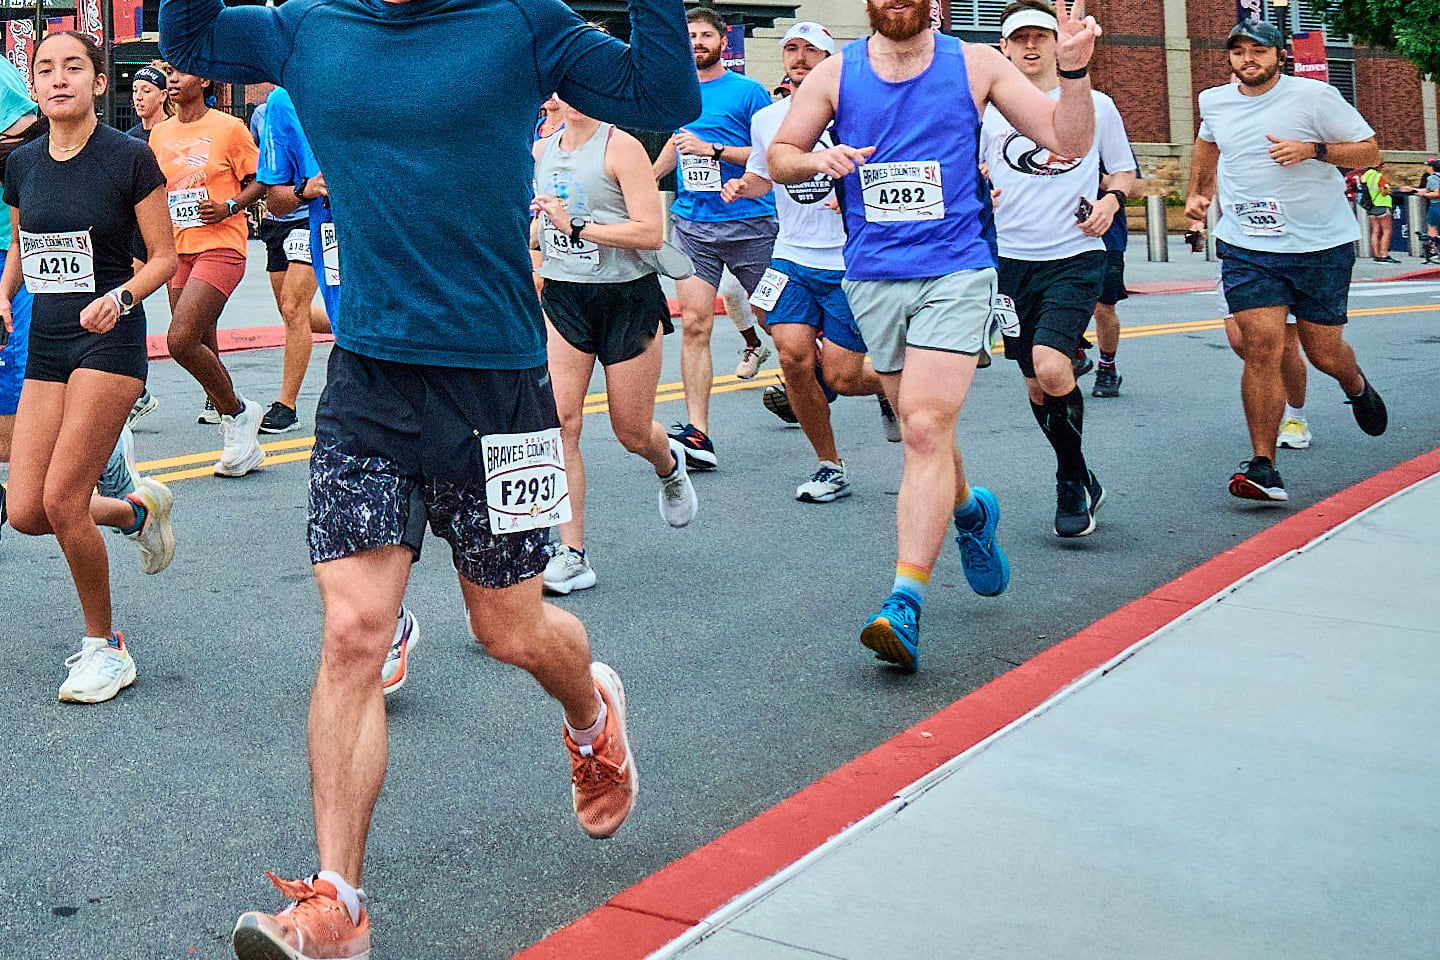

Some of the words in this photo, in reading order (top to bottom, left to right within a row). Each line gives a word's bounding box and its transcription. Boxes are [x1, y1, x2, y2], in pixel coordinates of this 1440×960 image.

[1294, 62, 1327, 72] Braves
[688, 170, 711, 181] A317
[863, 168, 888, 186] BRAVES
[890, 166, 921, 177] COUNTRY
[924, 165, 938, 183] 5K
[879, 187, 926, 205] A282
[45, 237, 75, 248] COUNTRY
[39, 256, 81, 275] A216
[487, 444, 525, 474] BRAVES
[501, 473, 556, 506] F2937
